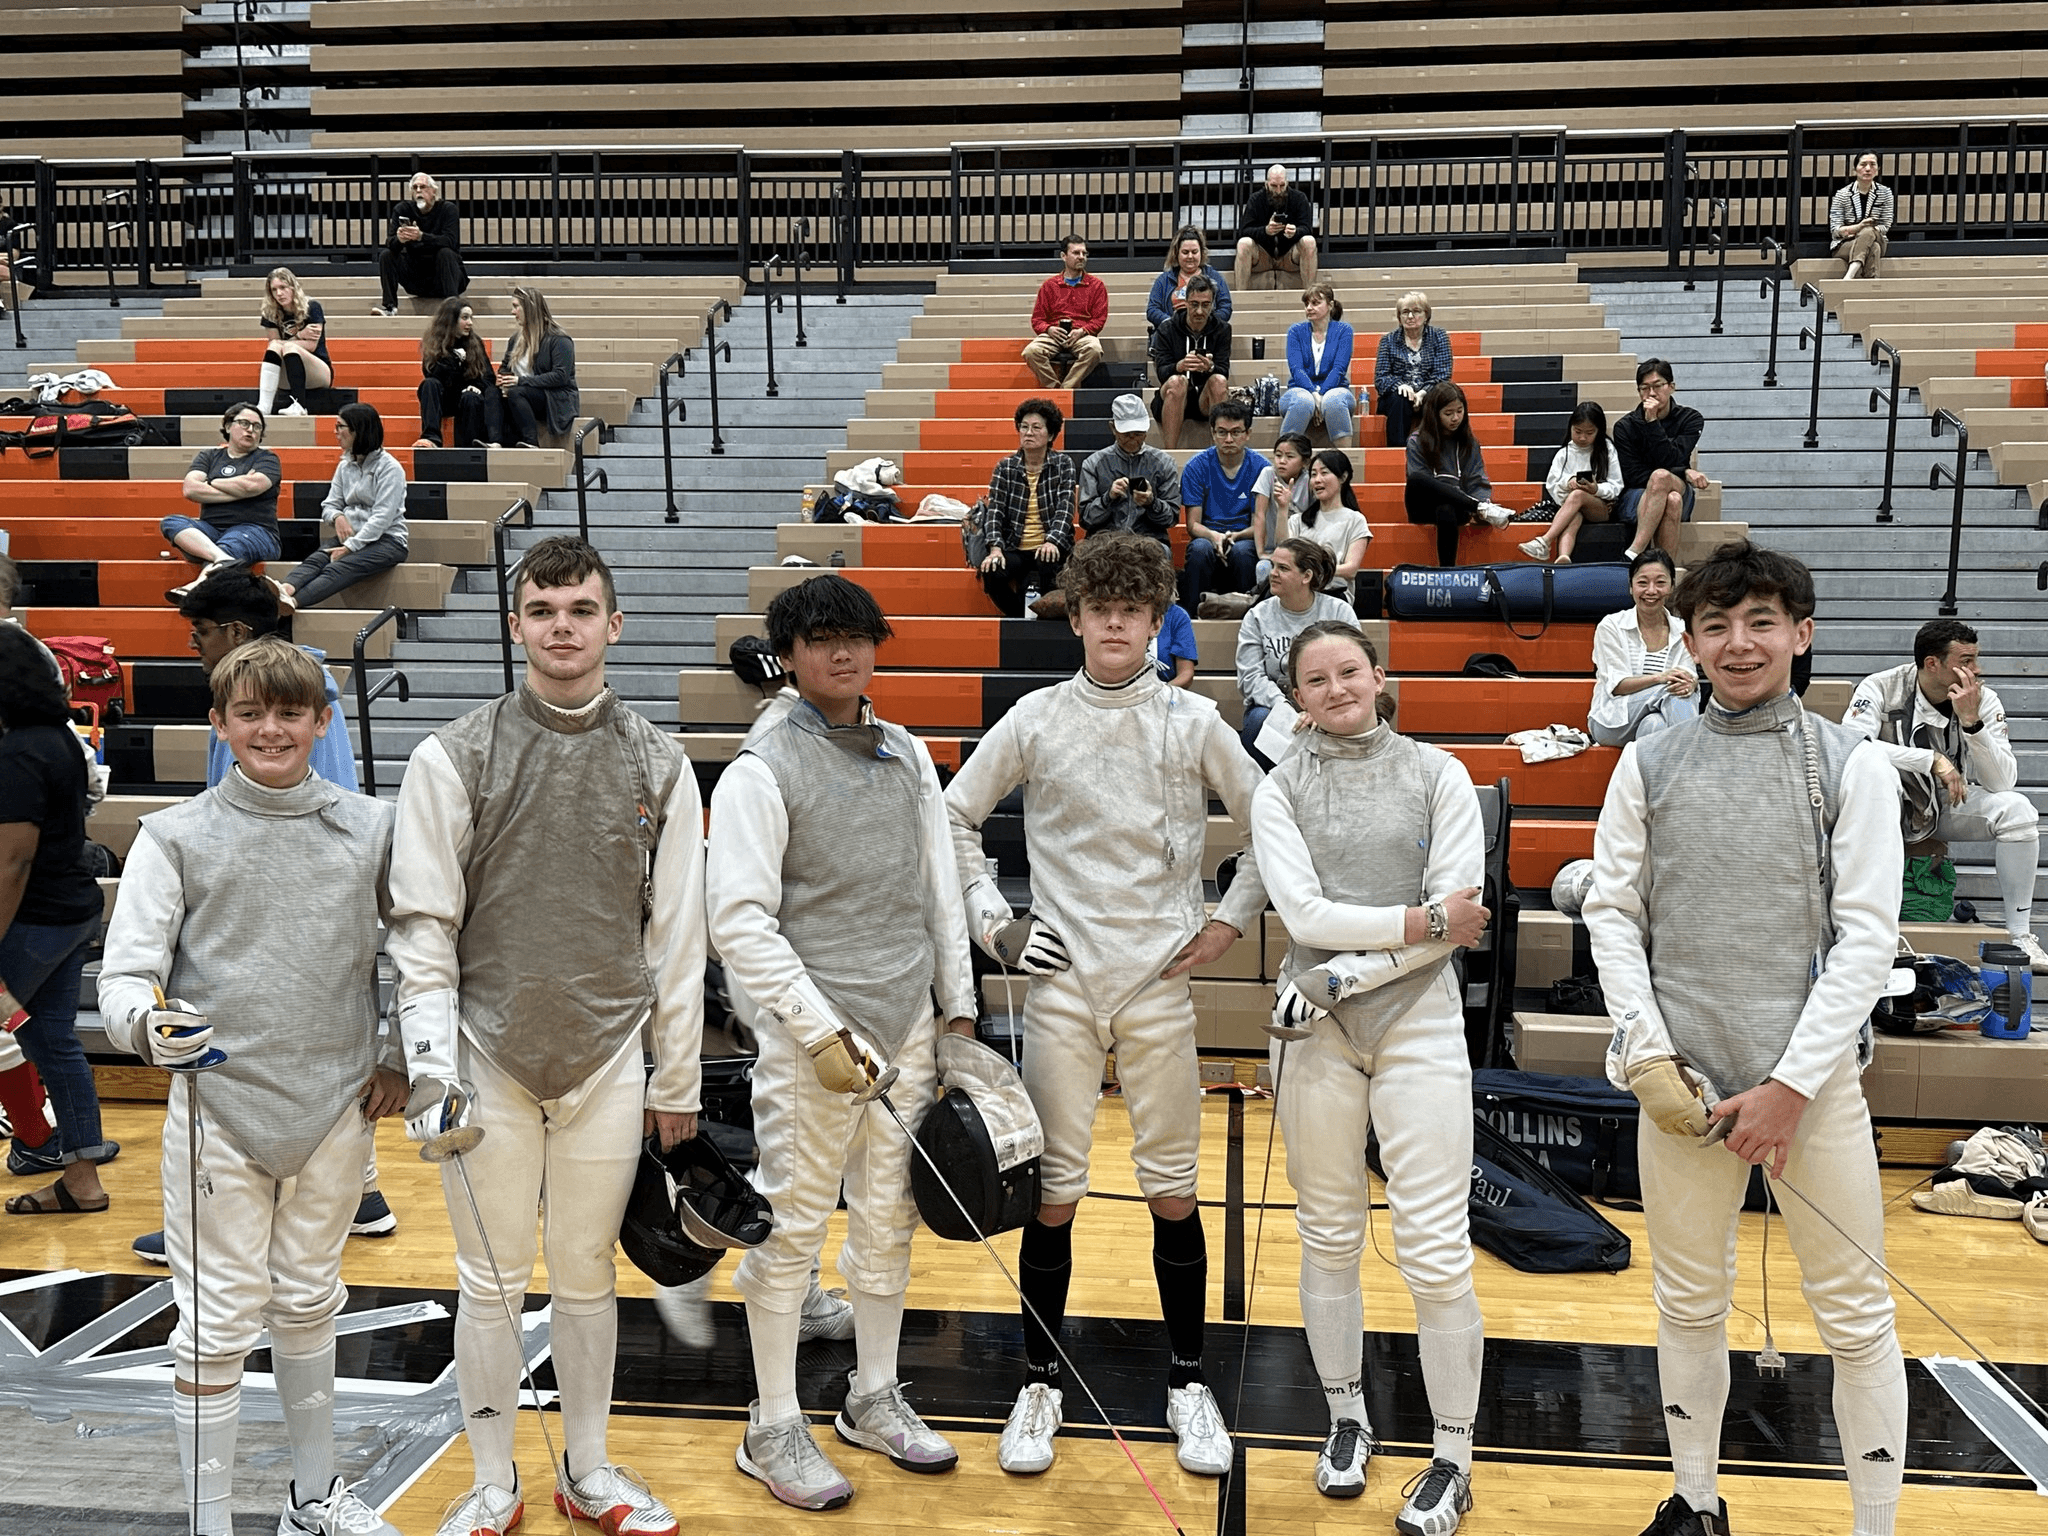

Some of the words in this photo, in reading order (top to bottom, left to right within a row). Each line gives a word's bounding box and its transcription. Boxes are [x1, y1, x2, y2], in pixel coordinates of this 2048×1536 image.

[1401, 572, 1479, 587] DEDENBACH
[1426, 588, 1452, 607] USA
[1471, 1165, 1512, 1207] Paul
[1175, 1355, 1198, 1367] Leon
[1435, 1419, 1465, 1434] Leon
